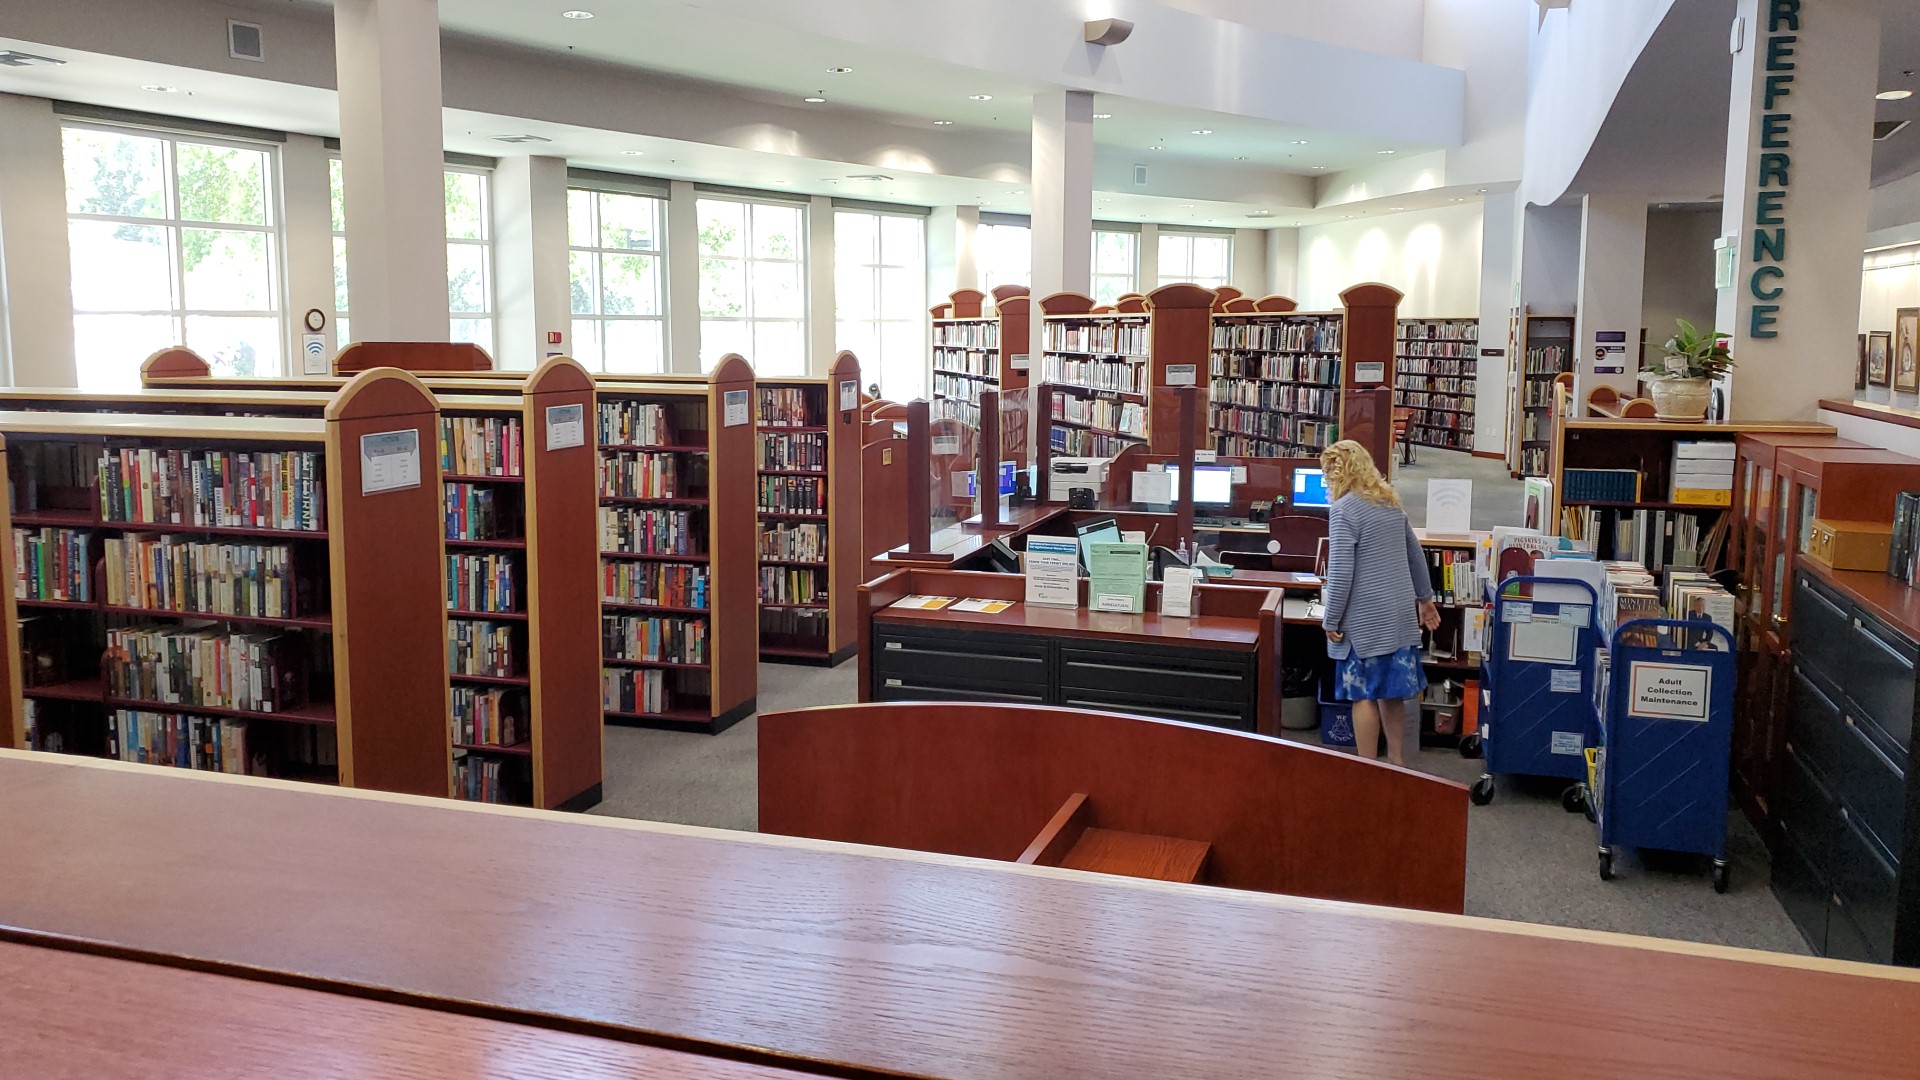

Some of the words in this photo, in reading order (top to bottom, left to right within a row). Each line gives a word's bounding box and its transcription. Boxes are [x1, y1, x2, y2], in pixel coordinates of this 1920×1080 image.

[1750, 0, 1800, 338] REFERENCE
[1648, 687, 1692, 696] Collection
[1640, 696, 1698, 706] Maintenance
